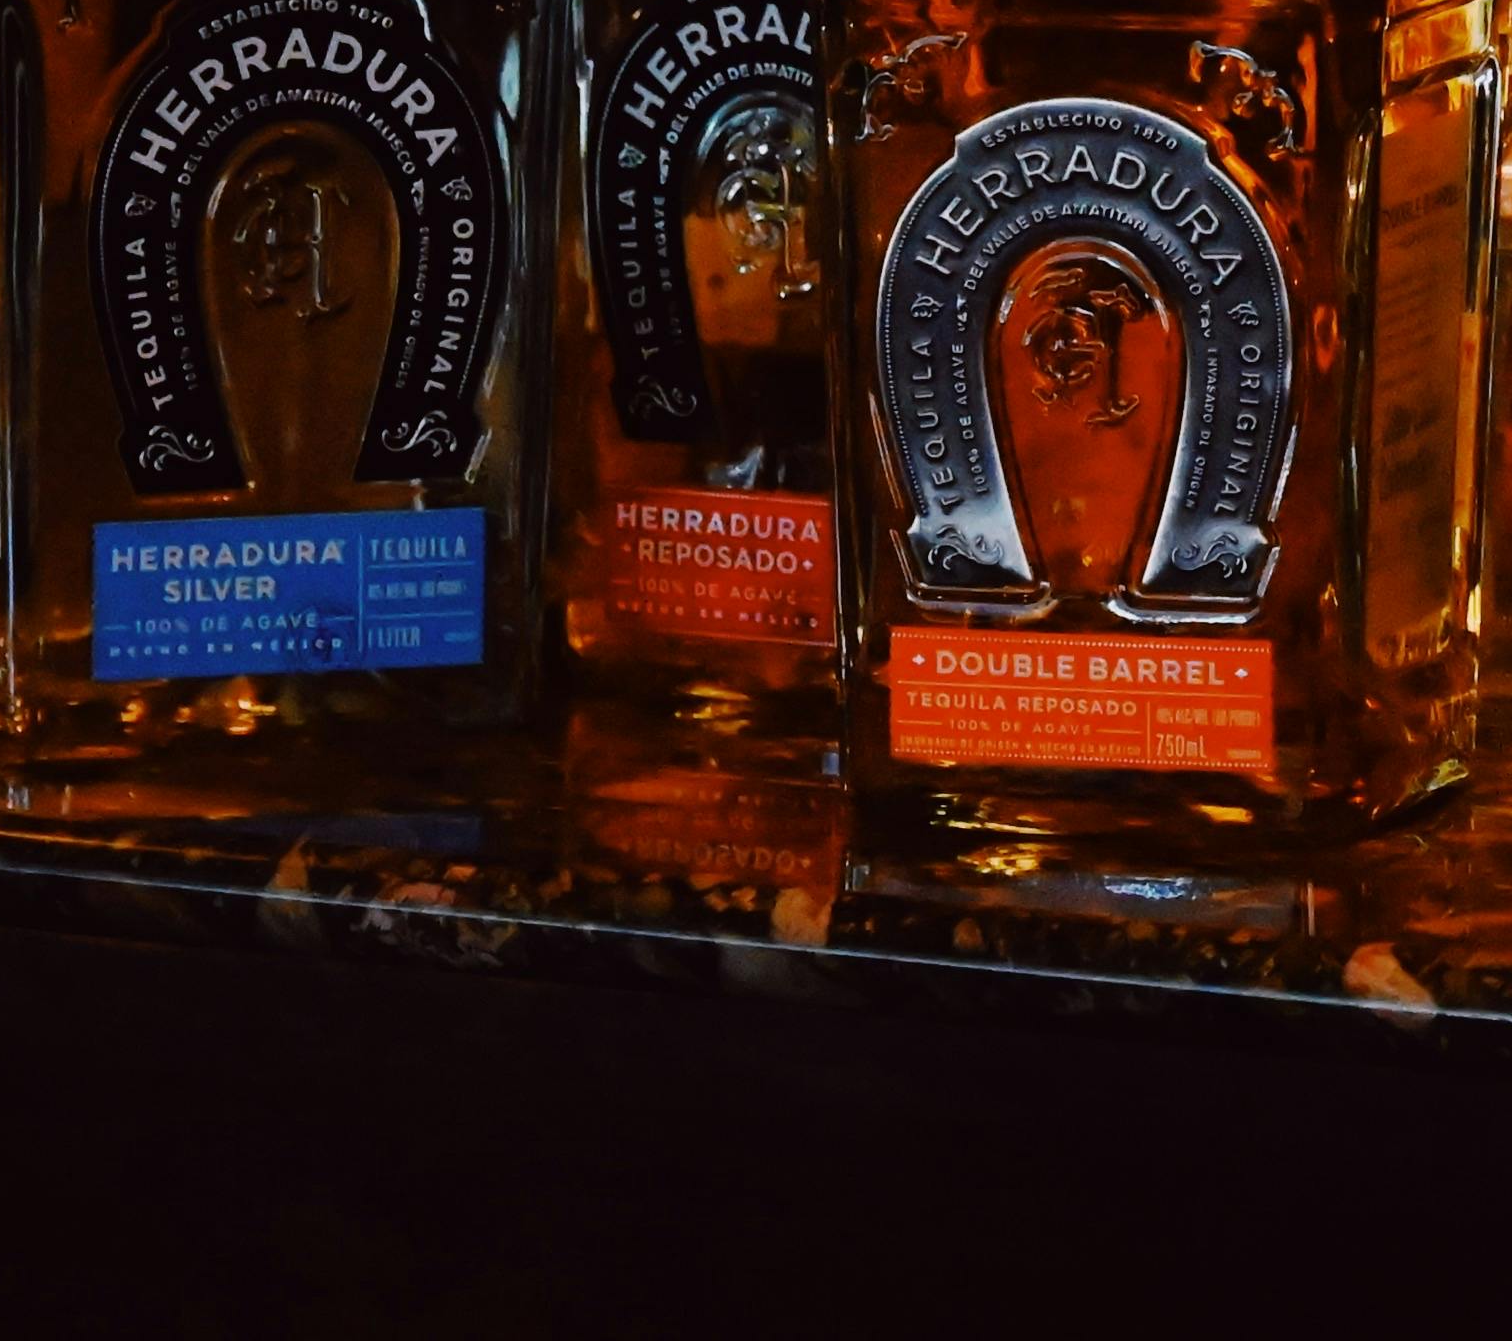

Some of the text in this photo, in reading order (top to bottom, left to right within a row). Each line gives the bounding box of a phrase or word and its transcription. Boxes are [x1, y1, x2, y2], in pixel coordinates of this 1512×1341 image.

[349, 4, 394, 29] 1870
[129, 27, 459, 175] HERRADURA
[666, 114, 689, 145] DEL
[685, 74, 726, 110] VALLE
[727, 64, 750, 81] DE
[177, 152, 203, 185] DEL
[197, 106, 242, 149] VALLE
[246, 93, 270, 113] DE
[367, 111, 416, 175] JALISCO
[981, 113, 1179, 151] ESTABLECIDO 1870
[915, 143, 1243, 286] HERRADURA
[966, 254, 990, 292] DEL
[981, 218, 1030, 258] VALLE
[1032, 203, 1057, 223] DE
[1150, 232, 1202, 297] JALISCO
[164, 241, 181, 303] AGAVE
[618, 188, 659, 361] TEQUILA
[125, 237, 175, 412] TEQUILA
[172, 313, 187, 338] DE
[423, 218, 474, 394] ORIGINAL
[910, 339, 962, 515] TEQUILA
[951, 343, 987, 495] 100% DE AGAVE
[1212, 344, 1261, 514] ORIGINAL
[615, 502, 821, 543] HERRADURA
[111, 539, 345, 573] HERRADURA
[369, 536, 467, 561] TEQUILA
[638, 538, 798, 574] REPOSADO
[163, 576, 276, 603] SILVER
[694, 582, 720, 598] DE
[729, 585, 797, 605] AGAVE
[201, 617, 228, 632] DE
[242, 612, 318, 630] AGAVE
[935, 649, 1225, 686] DOUBLE BARREL
[906, 691, 1007, 711] TEQUILA
[1017, 696, 1138, 717] REPOSADO
[949, 719, 1090, 735] 100% DE AGAVE
[1156, 733, 1207, 759] 750mL
